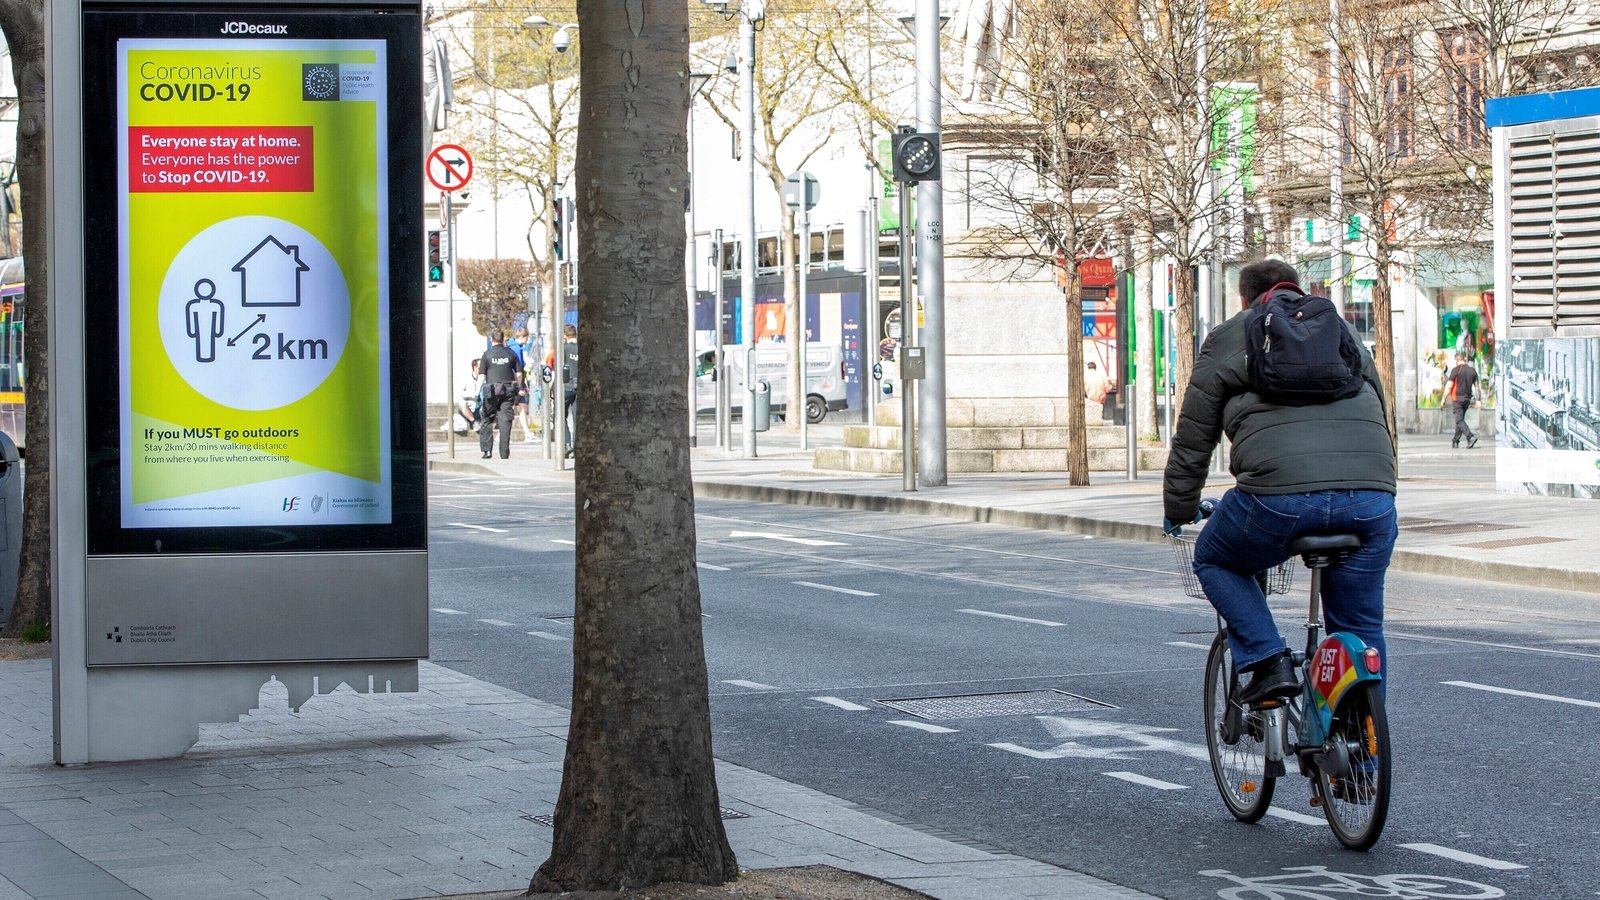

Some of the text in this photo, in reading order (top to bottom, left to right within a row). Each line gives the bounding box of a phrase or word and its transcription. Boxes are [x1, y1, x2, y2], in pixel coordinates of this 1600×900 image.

[220, 21, 288, 35] JCDecaux
[140, 61, 262, 80] Coronavirus
[140, 83, 251, 102] COVID-19
[141, 134, 301, 149] Everyone stay at home.
[142, 152, 300, 167] Everyone has the power
[141, 170, 270, 185] to Stop COVID-19.
[251, 332, 328, 360] 2 km
[144, 426, 299, 441] If you MUST go outdoors
[144, 443, 163, 452] Stay
[164, 443, 197, 451] 2km/30
[219, 442, 252, 451] walking
[253, 442, 288, 450] distance
[166, 455, 192, 463] where
[193, 456, 208, 465] you
[225, 454, 248, 462] when
[249, 454, 290, 463] exercising
[1319, 648, 1338, 666] JUST
[1321, 666, 1336, 683] EAT
